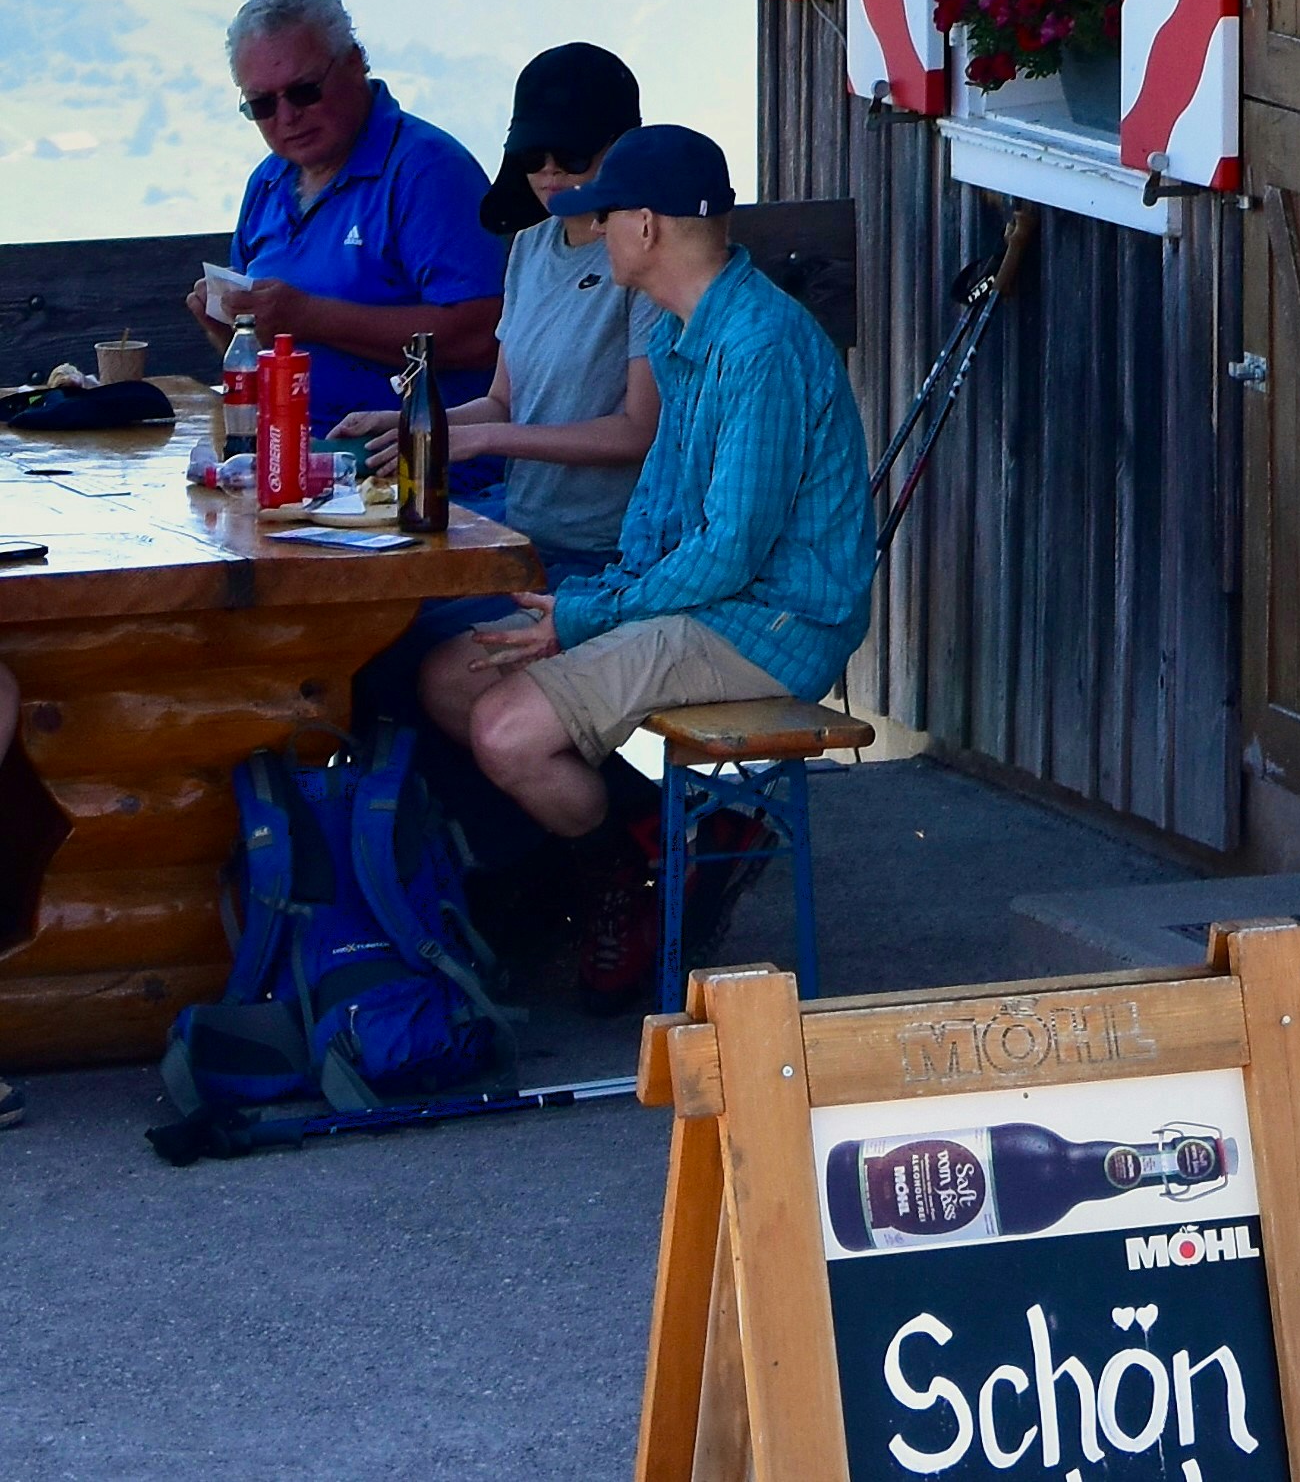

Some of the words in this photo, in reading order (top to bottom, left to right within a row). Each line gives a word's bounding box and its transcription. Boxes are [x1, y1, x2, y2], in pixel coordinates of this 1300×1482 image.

[271, 426, 283, 475] ENERVIT
[911, 1153, 928, 1223] ALKOHOLFREI
[936, 1149, 952, 1186] vom
[954, 1162, 979, 1209] Saft
[883, 1302, 1260, 1475] Schön
